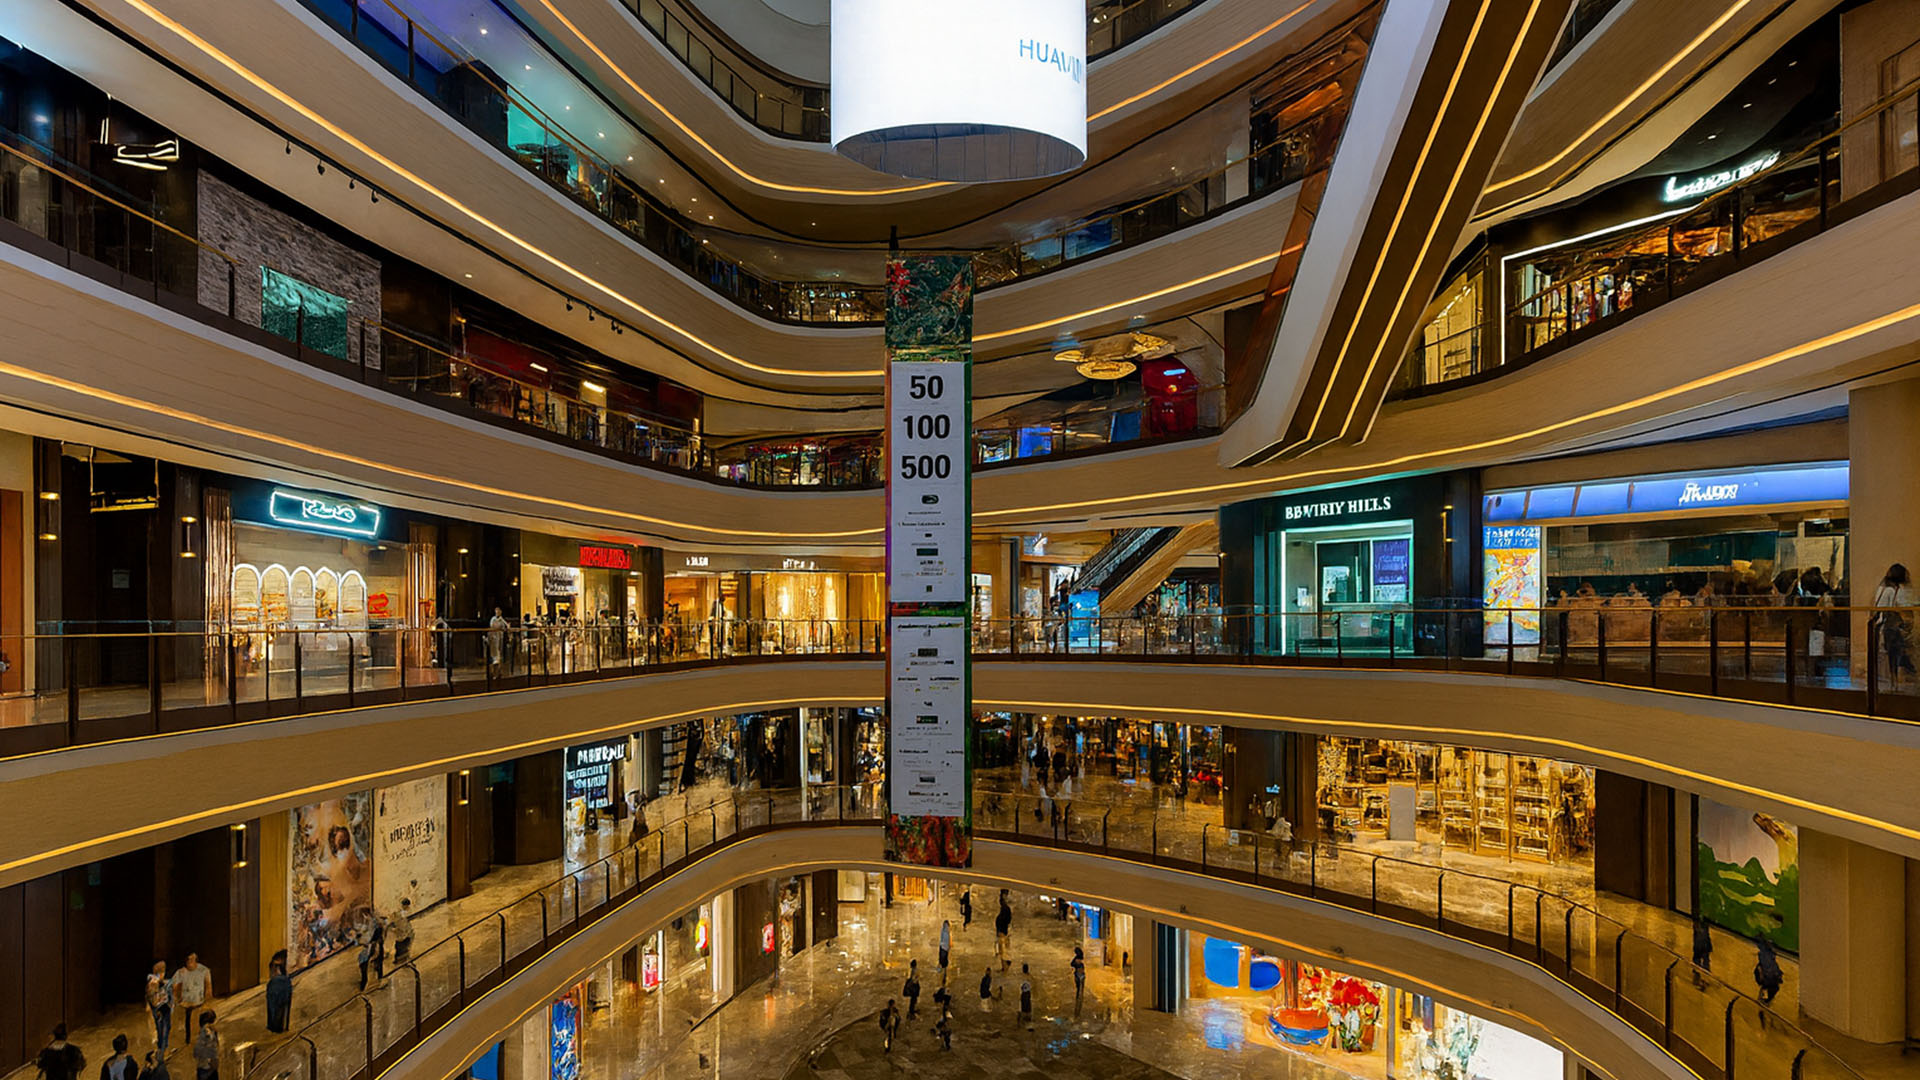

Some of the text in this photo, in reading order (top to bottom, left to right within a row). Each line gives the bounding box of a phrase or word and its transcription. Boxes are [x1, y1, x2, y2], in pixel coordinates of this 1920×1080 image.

[909, 374, 944, 400] 50
[901, 413, 951, 440] 100
[900, 454, 951, 480] 500
